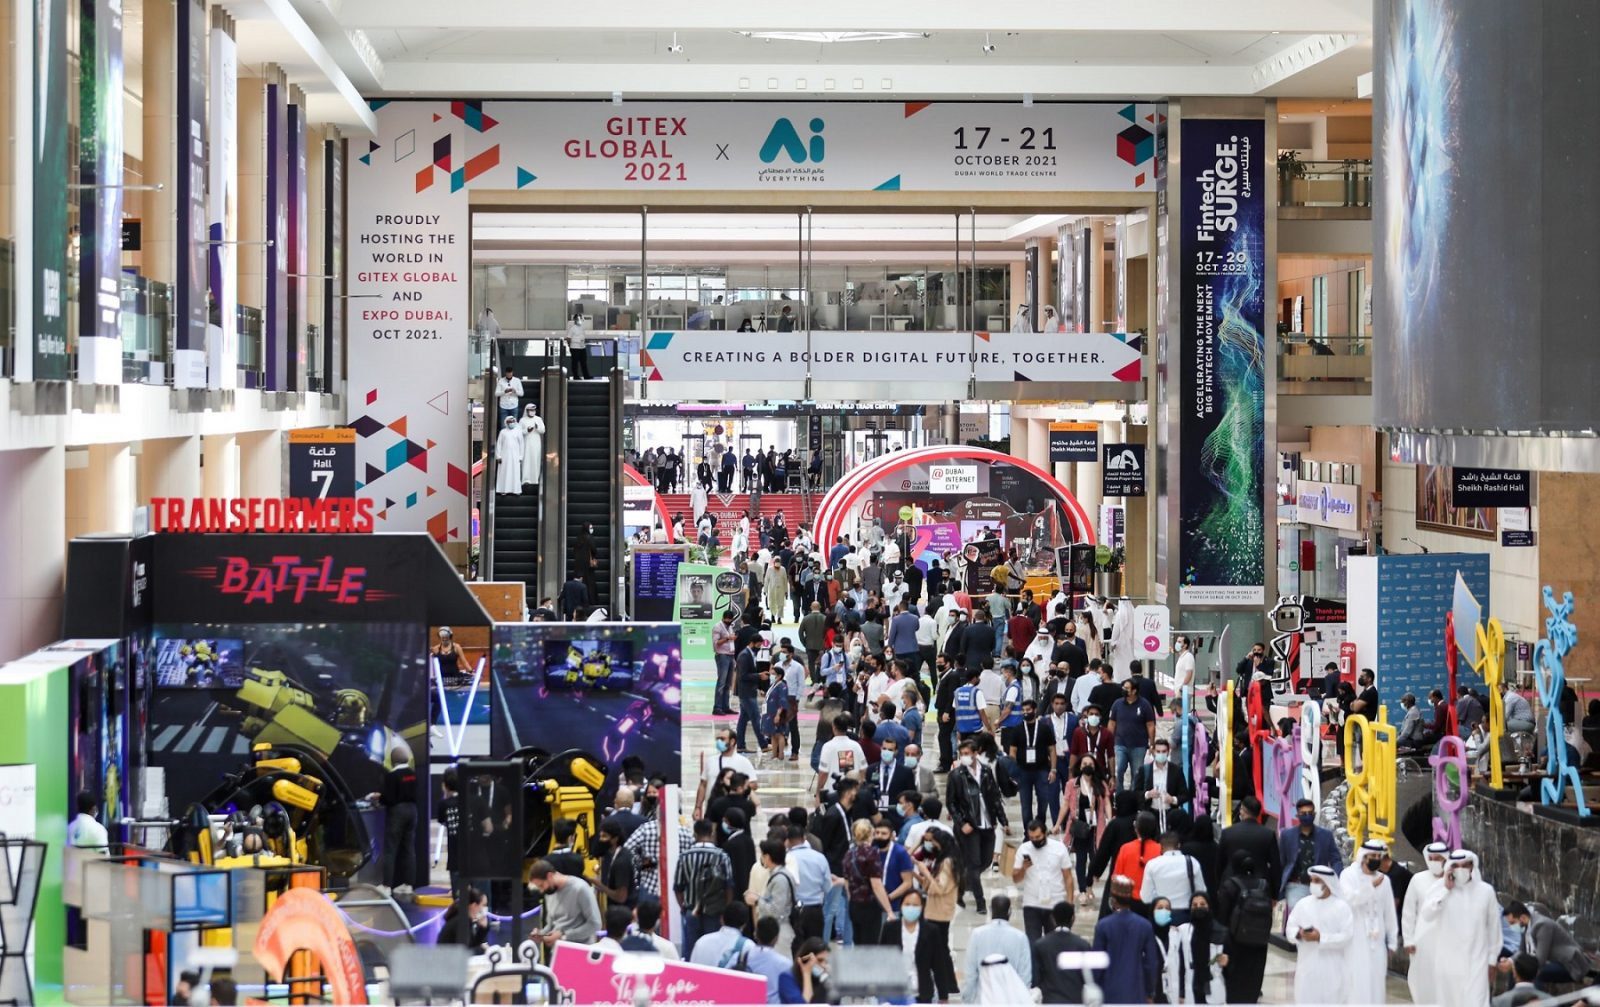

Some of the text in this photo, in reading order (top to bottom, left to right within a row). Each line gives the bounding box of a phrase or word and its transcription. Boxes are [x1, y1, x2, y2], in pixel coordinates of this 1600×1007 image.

[607, 117, 687, 136] GITEX
[564, 139, 673, 158] GLOBAL
[954, 155, 1057, 166] OCTOBER 2021
[624, 162, 688, 181] 2021
[1215, 135, 1238, 232] SURGE.
[1196, 169, 1215, 241] Fintech
[375, 214, 441, 226] PROUDLY
[360, 233, 456, 245] HOSTING THE
[371, 252, 444, 264] WORLD IN
[1196, 263, 1247, 272] OCT 2021
[357, 271, 458, 283] GITEX GLOBAL
[392, 290, 423, 302] AND
[362, 309, 453, 323] EXPO DUBAI,
[372, 329, 443, 340] OCT 2021.
[1196, 284, 1204, 419] ACCELERATING THE NEXT
[1205, 284, 1213, 413] BIG FINTECH MOVEMENT
[682, 351, 1105, 366] CREATING A BOLDER DIGITAL FUTURE, TOGETHER.
[309, 446, 337, 456] قاعة
[313, 459, 333, 468] Hall
[1460, 472, 1522, 482] قاعة الشيخ راشد
[311, 470, 335, 502] 7
[1457, 484, 1525, 492] Sheikh Rashid Hall
[150, 497, 374, 534] TRANSFORMERS
[220, 555, 367, 604] BATTLE
[665, 978, 699, 1002] you
